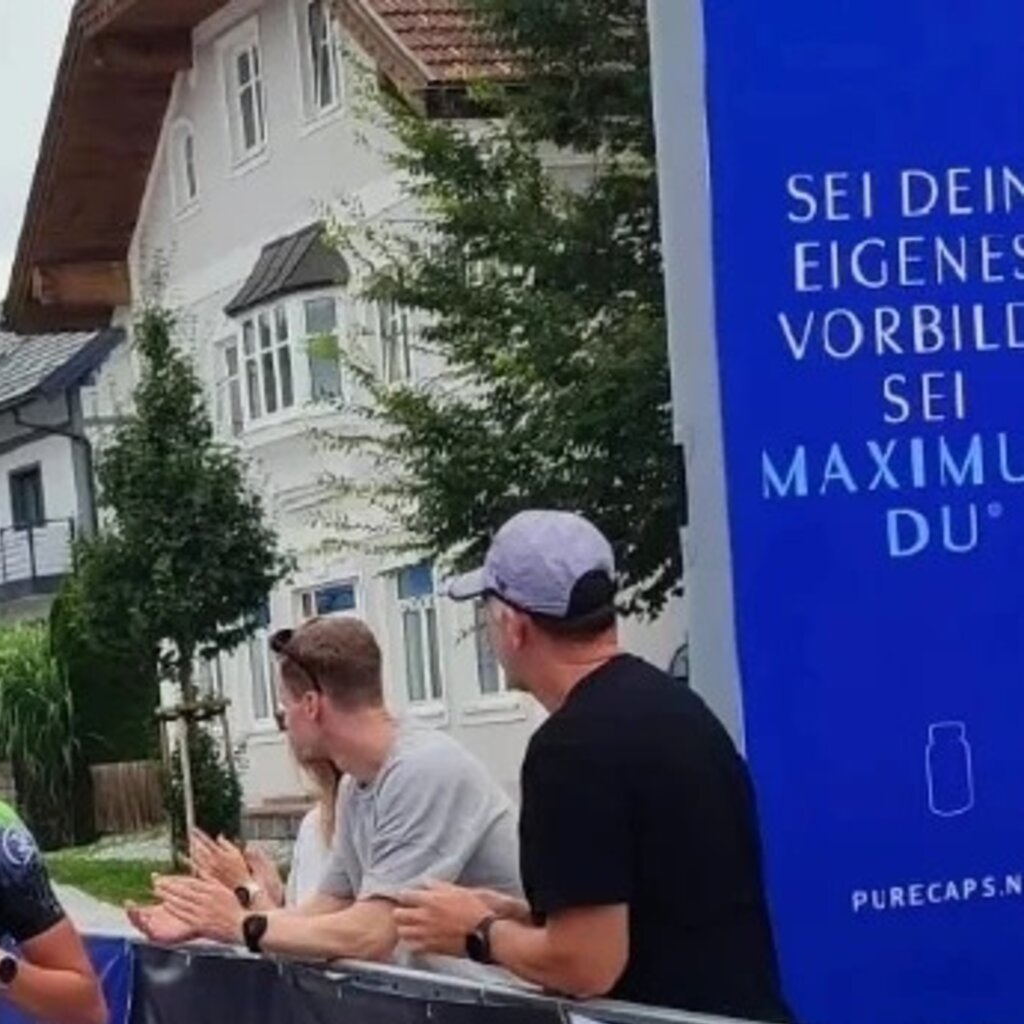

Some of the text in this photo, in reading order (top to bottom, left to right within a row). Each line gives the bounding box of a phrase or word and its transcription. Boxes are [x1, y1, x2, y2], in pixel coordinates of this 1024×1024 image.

[787, 166, 1024, 223] SEI DEIN
[883, 371, 964, 424] SEI
[851, 874, 1022, 912] PURECAPS.N
